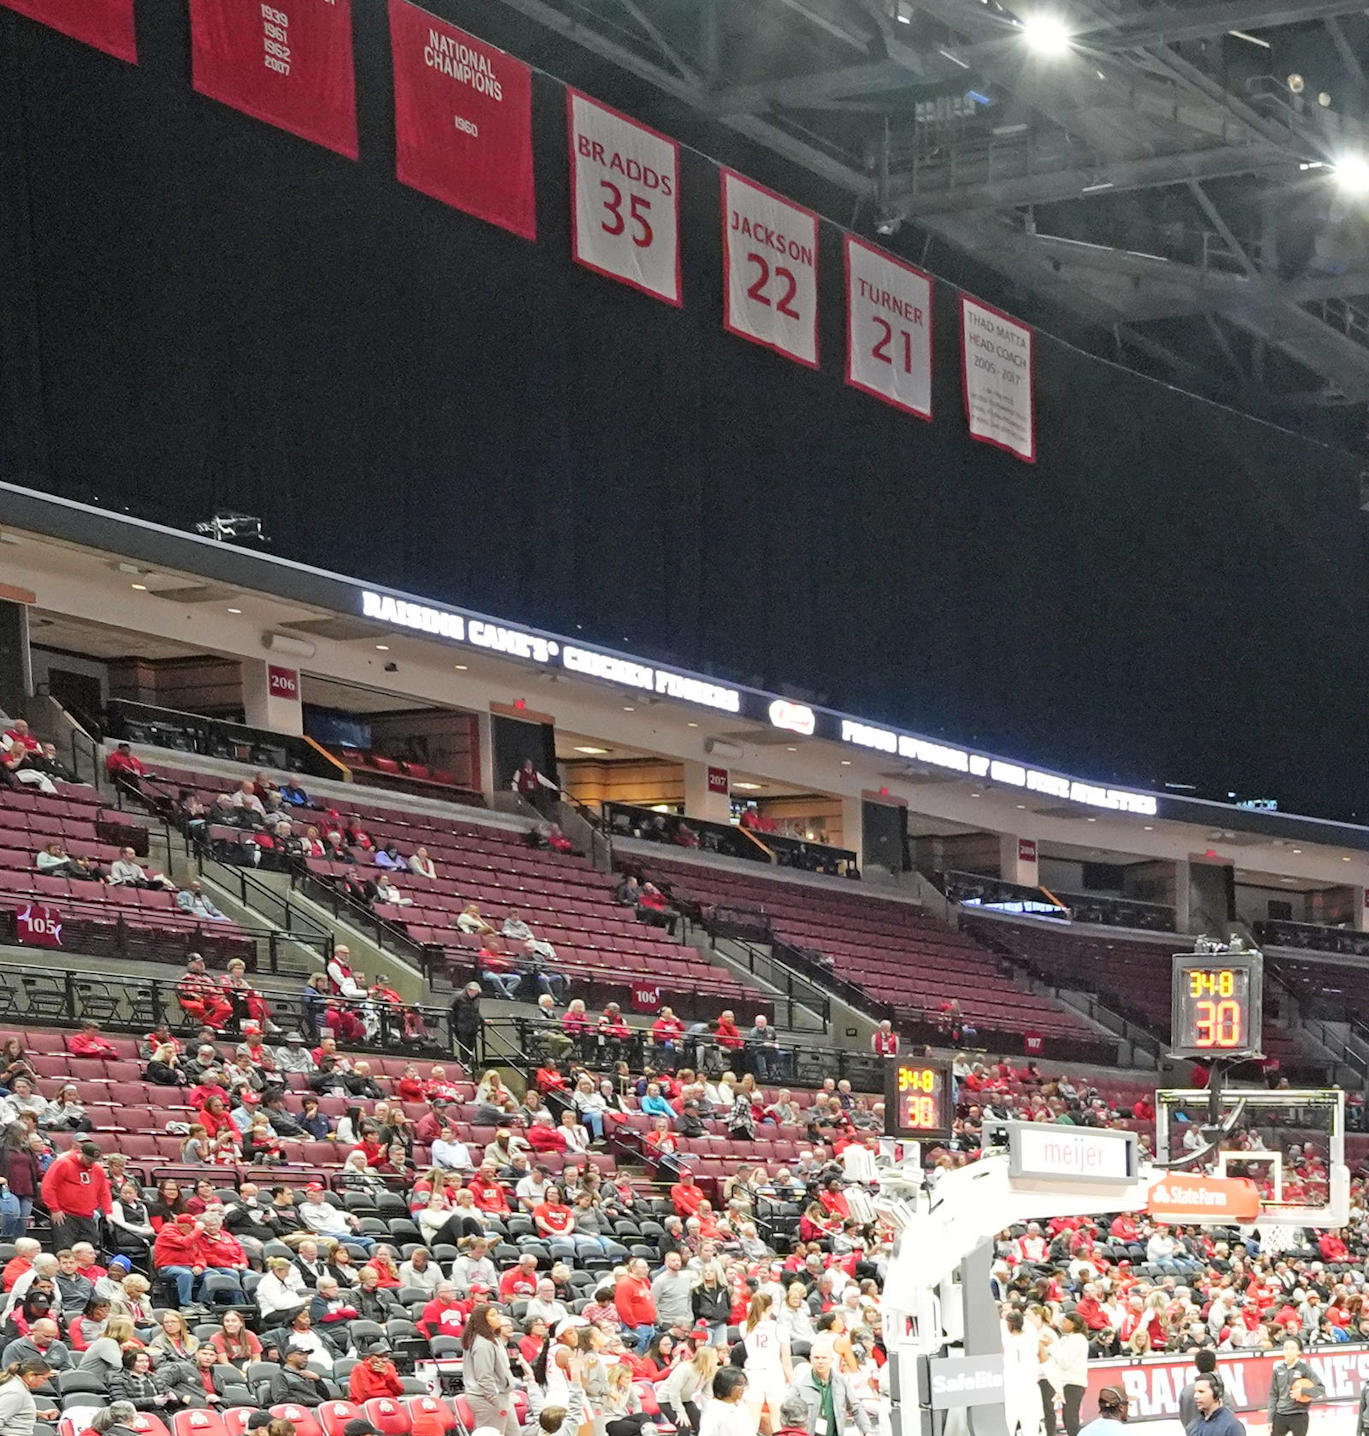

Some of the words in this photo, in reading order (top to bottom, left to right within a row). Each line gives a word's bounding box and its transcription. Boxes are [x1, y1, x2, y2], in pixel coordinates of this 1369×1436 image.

[260, 4, 288, 27] 1939
[264, 23, 288, 44] 1961
[264, 39, 290, 60] 1962
[264, 56, 290, 76] 2007
[429, 29, 496, 79] NATIONAL
[424, 47, 502, 101] CHAMPIONS
[454, 115, 478, 138] 1960
[578, 133, 672, 197] BRADDS
[600, 180, 653, 248] 35
[730, 211, 813, 267] JACKSON
[747, 253, 800, 320] 22
[857, 277, 923, 327] TURNER
[872, 316, 911, 374] 21
[968, 311, 994, 334] THAD
[996, 325, 1026, 348] MATTA
[969, 333, 994, 353] HEAD
[996, 345, 1027, 369] COACH
[363, 591, 464, 640] RAISING
[563, 647, 654, 692] CHICKEN
[656, 670, 739, 713] FINGERS
[271, 675, 296, 691] 206
[709, 775, 726, 786] 207
[27, 917, 56, 935] 105
[636, 991, 656, 1004] 106
[1196, 1000, 1240, 1047] 30
[1027, 1037, 1041, 1048] 107
[906, 1095, 934, 1127] 30
[1044, 1138, 1104, 1171] meijer
[756, 1334, 768, 1348] 12
